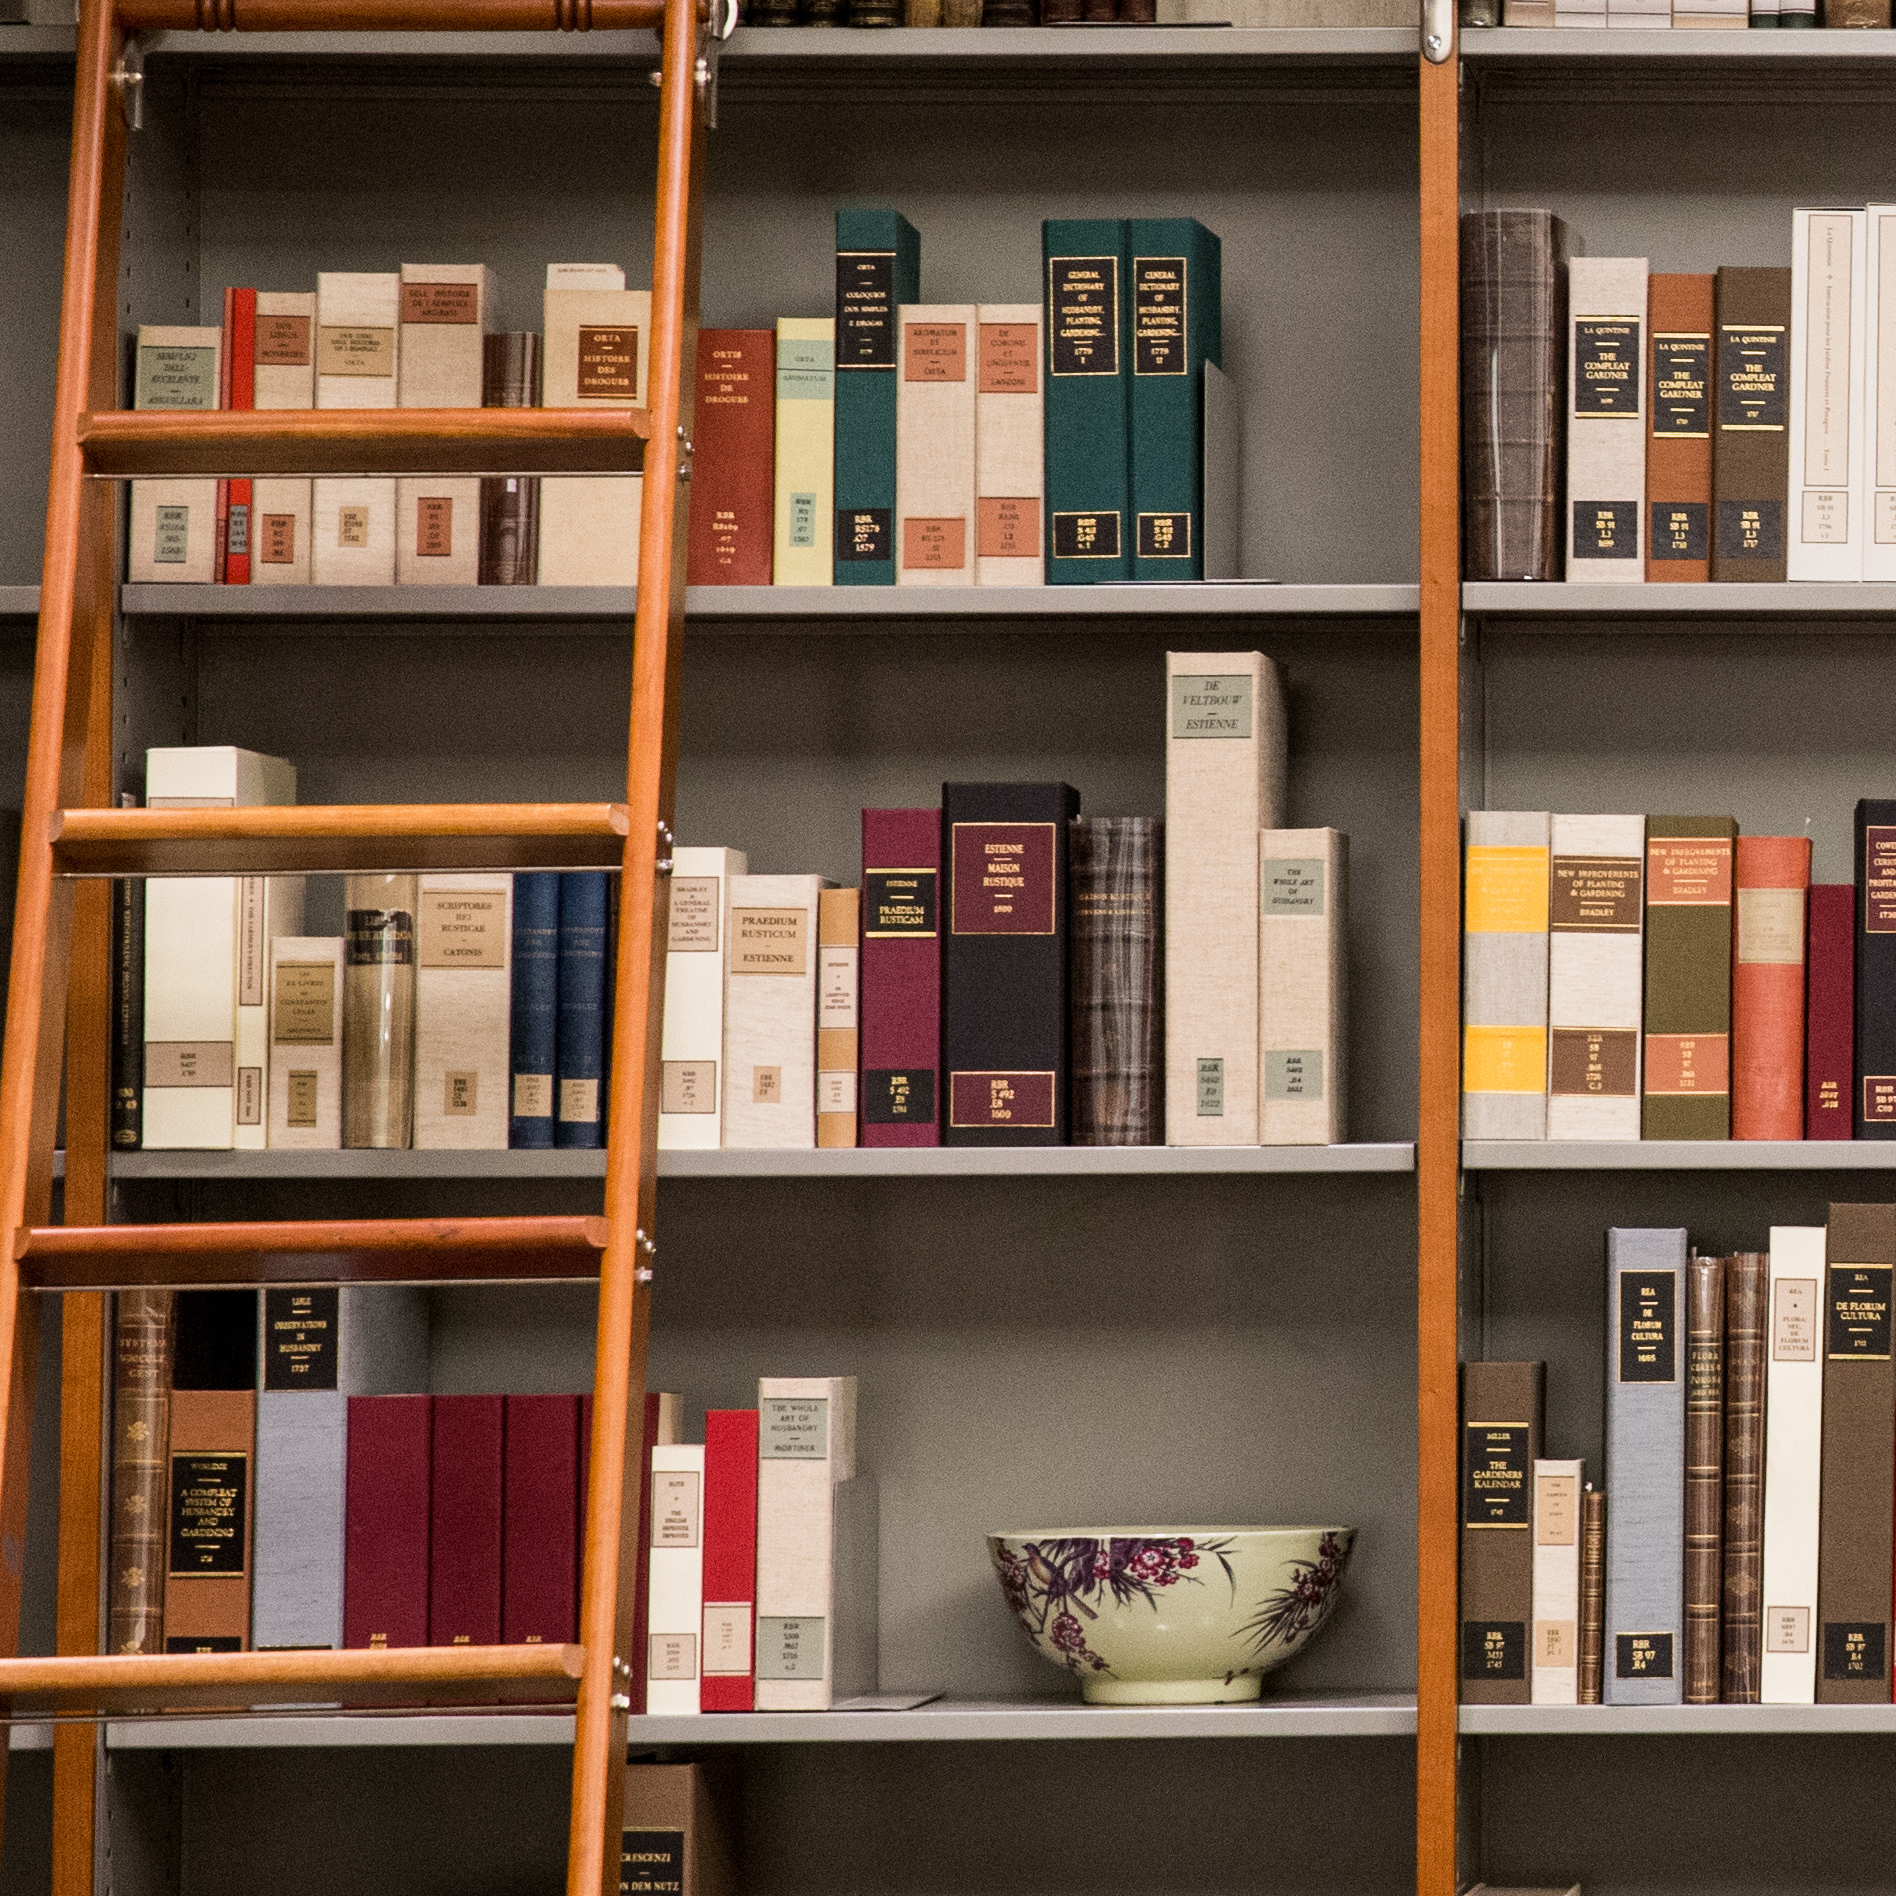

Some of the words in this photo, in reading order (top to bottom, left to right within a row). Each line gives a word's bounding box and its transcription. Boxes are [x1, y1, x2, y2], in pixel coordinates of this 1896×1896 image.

[1584, 327, 1594, 335] LA
[1730, 335, 1740, 344] LA
[584, 355, 630, 363] HISTOIRE
[1599, 353, 1616, 361] THE
[1584, 362, 1631, 370] COMPLEAT
[1744, 364, 1763, 373] THE
[584, 377, 630, 385] DROGUES
[704, 373, 750, 381] HISTOIRE
[1729, 373, 1776, 382] COMPLEAT
[1658, 381, 1704, 389] COMPLEAT
[705, 395, 749, 403] DROGUES
[1204, 681, 1221, 691] DE
[1183, 695, 1243, 705] VELTBOUW
[1185, 719, 1239, 729] ESTIENNE
[985, 844, 1024, 854] ESTIENNE
[1650, 848, 1667, 856] NEW
[1671, 848, 1731, 856] IMPROVEMENTS
[1665, 858, 1675, 866] OF
[1679, 858, 1717, 867] PLANTING
[987, 863, 1020, 873] MAISON
[1663, 867, 1670, 876] &
[1672, 867, 1718, 876] GARDENING
[1557, 869, 1574, 878] NEW
[1578, 870, 1639, 878] IMPROVEMENTS
[983, 877, 1024, 888] RUSTIQUE
[1572, 879, 1584, 888] OF
[1587, 880, 1625, 888] PLANTING
[1570, 889, 1578, 897] &
[1580, 889, 1625, 898] GARDENING
[1672, 886, 1707, 895] BRADLEY
[437, 902, 492, 910] SCRIPTORES
[879, 906, 925, 914] PRAEDIUM
[1579, 908, 1614, 917] BRADLEY
[742, 916, 797, 926] PRAEDIUM
[441, 924, 485, 932] RUSTICAE
[741, 929, 796, 938] RUSTICUM
[442, 948, 483, 957] CATONIS
[743, 954, 794, 963] ESTIENNE
[991, 1080, 1008, 1088] RBR
[991, 1090, 997, 1099] S
[999, 1090, 1015, 1099] 492
[1640, 1288, 1656, 1296] REA
[1835, 1301, 1848, 1310] DE
[1849, 1302, 1886, 1311] FLORUM
[1642, 1308, 1653, 1317] DE
[1839, 1311, 1881, 1320] CULTURA
[274, 1321, 327, 1330] OBSERVATIONS
[1631, 1332, 1664, 1341] CULTURA
[279, 1344, 322, 1353] HUSBANDRY
[772, 1404, 787, 1412] THE
[790, 1404, 818, 1412] WHOLE
[1489, 1461, 1507, 1470] THE
[1473, 1470, 1523, 1479] GARDENERS
[1474, 1479, 1521, 1488] KALENDAR
[180, 1488, 187, 1496] A
[189, 1488, 239, 1497] COMPLEAT
[185, 1498, 216, 1507] SYSTEM
[219, 1498, 232, 1507] OF
[181, 1508, 235, 1517] HUSBANDRY
[197, 1518, 218, 1526] AND
[179, 1528, 234, 1537] GARDENING
[1486, 1632, 1503, 1640] RBR
[1847, 1633, 1864, 1642] RBR
[1484, 1642, 1494, 1650] SB
[1632, 1640, 1650, 1649] RBR
[1846, 1643, 1855, 1651] SB
[1632, 1650, 1643, 1660] SB
[1645, 1650, 1656, 1660] 97
[631, 1881, 652, 1891] DEM
[654, 1881, 680, 1891] NUTZ
